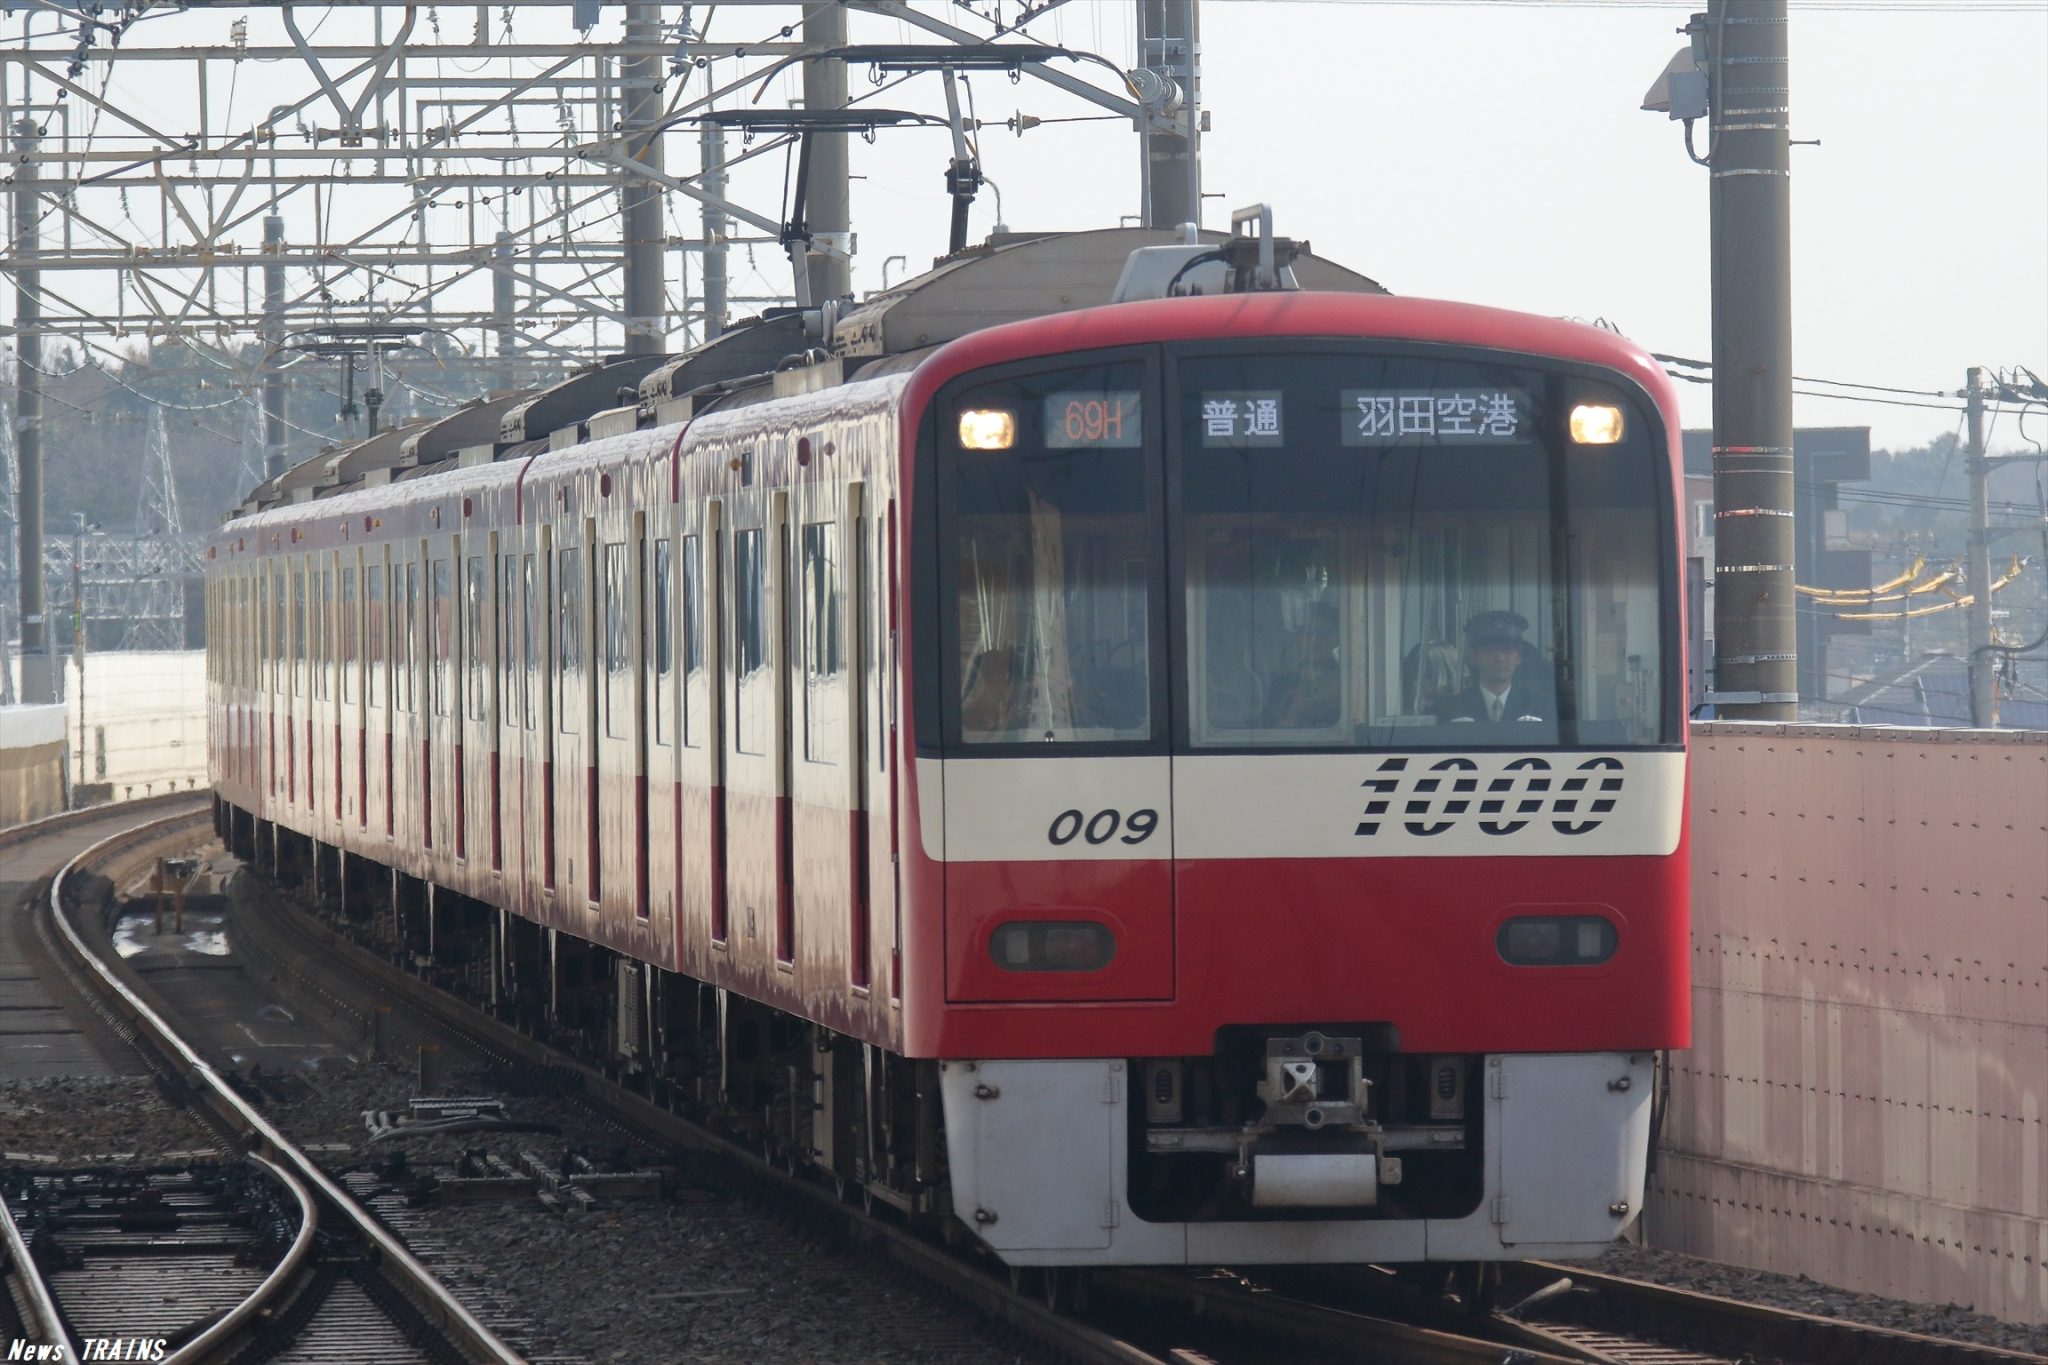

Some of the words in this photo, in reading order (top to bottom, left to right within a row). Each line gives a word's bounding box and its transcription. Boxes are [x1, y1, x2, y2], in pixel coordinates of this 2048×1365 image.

[1065, 400, 1122, 440] 69H
[1202, 400, 1279, 436] 普通
[1357, 393, 1518, 436] 羽田空港
[1354, 757, 1624, 836] 1000
[1048, 808, 1158, 846] 009
